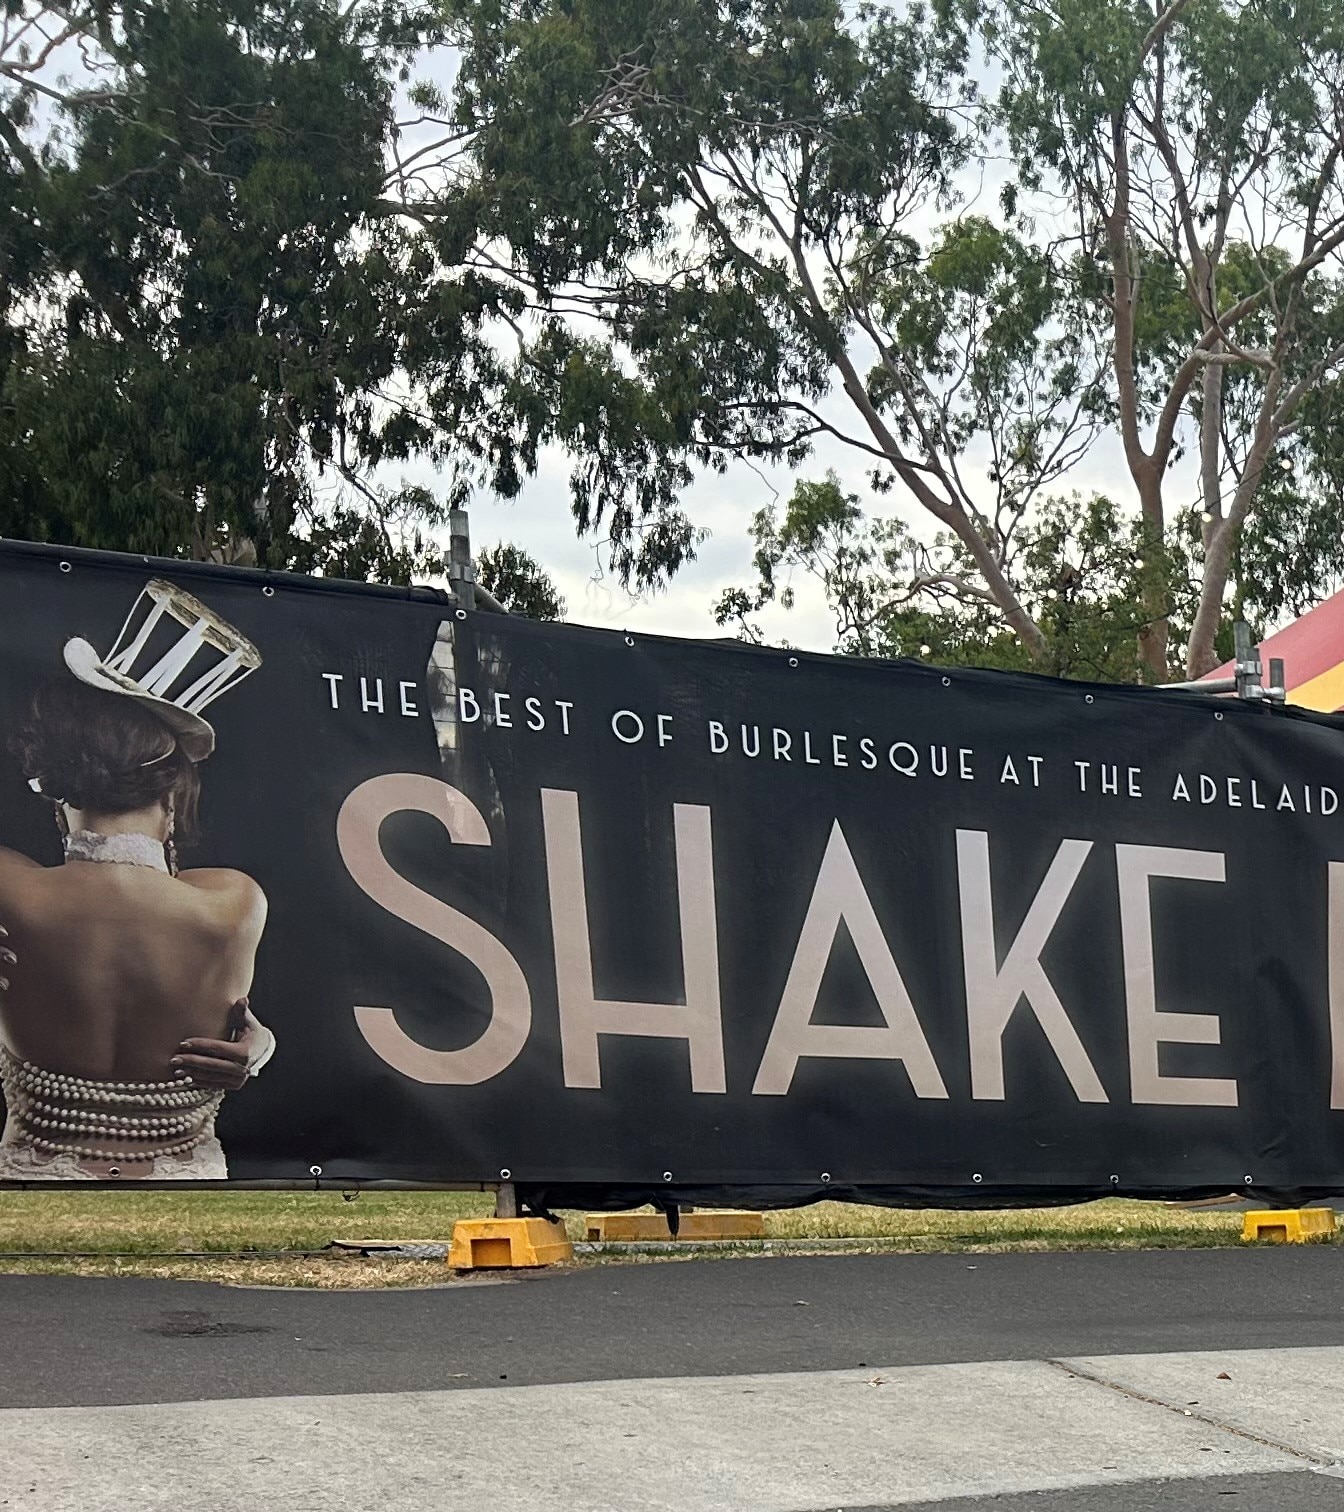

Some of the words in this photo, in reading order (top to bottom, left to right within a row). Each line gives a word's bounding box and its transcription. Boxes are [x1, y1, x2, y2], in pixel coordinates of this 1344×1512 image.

[322, 672, 420, 717] THE
[460, 687, 574, 736] BEST
[611, 709, 675, 748] OF
[709, 720, 975, 782] BURLESQUE
[1000, 755, 1044, 788] AT
[1075, 760, 1143, 799] THE
[335, 772, 1239, 1108] SHAKE
